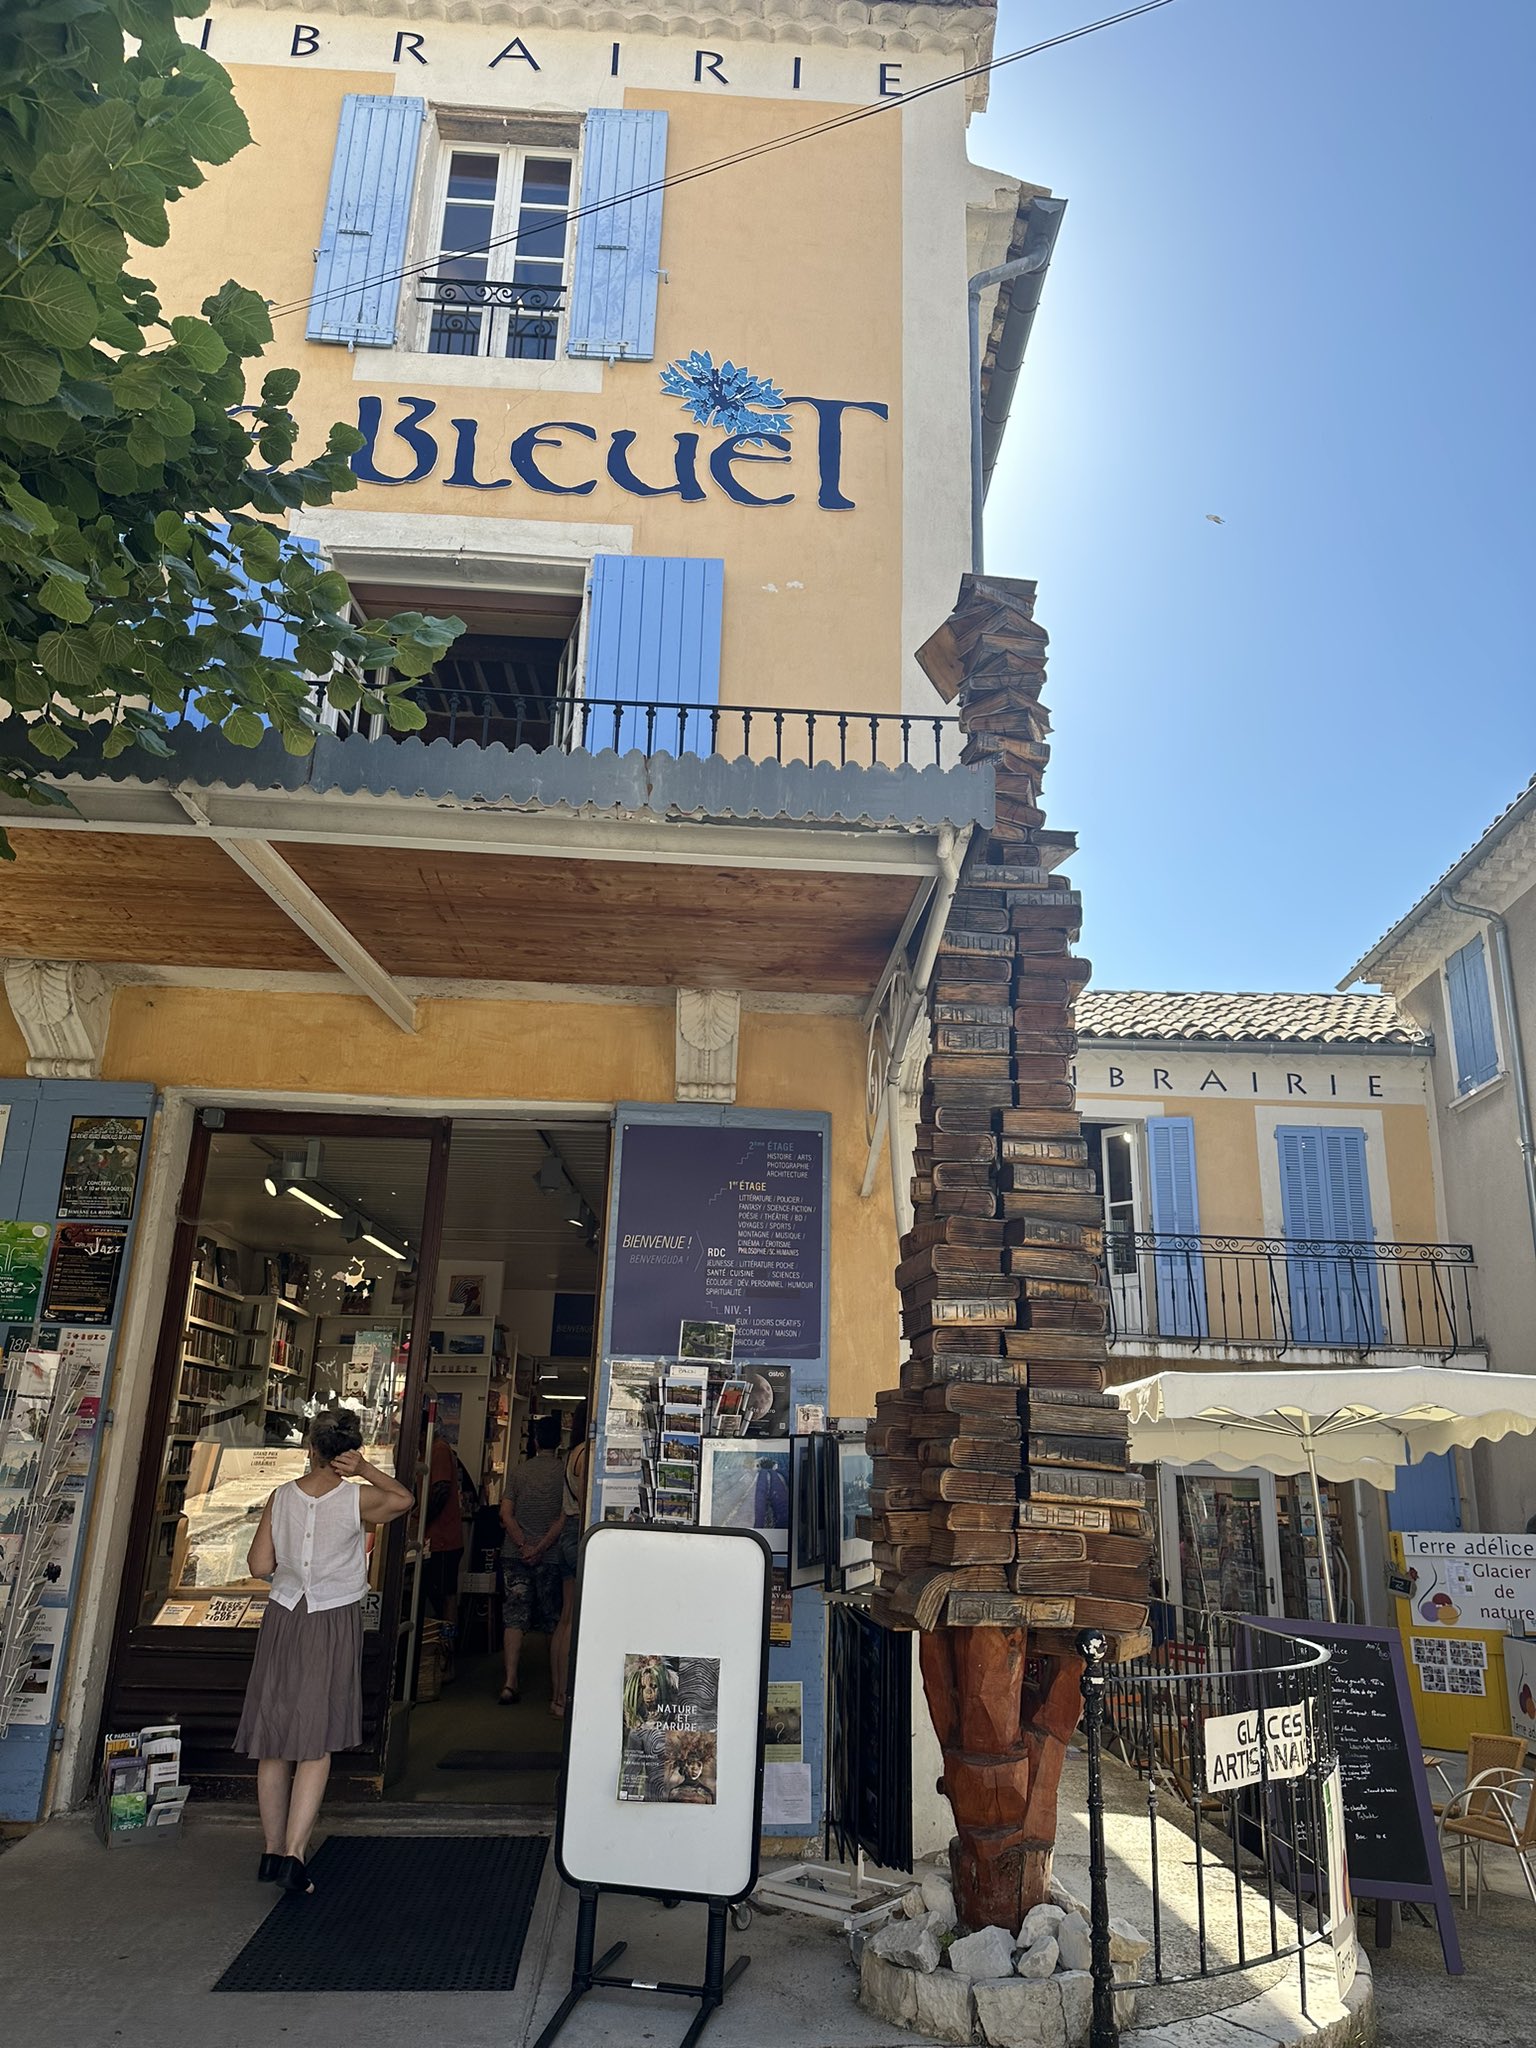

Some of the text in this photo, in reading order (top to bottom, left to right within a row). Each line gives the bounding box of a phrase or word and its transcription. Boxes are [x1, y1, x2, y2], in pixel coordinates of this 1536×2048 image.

[200, 18, 903, 98] IBRAIRIE
[1072, 1065, 1383, 1097] IBRAIRIE
[767, 1140, 794, 1151] ÉTAGE
[739, 1180, 767, 1191] ÉTAGE
[739, 1194, 772, 1202] LITTÉRATURE
[739, 1203, 814, 1213] FANTASY SCIENCE-FICTION
[738, 1211, 759, 1219] POÉSIE
[764, 1212, 789, 1221] THÉÂTRE
[738, 1221, 764, 1229] VOYAGES
[737, 1231, 801, 1240] MONTAGNE MUSIQUE
[622, 1234, 686, 1249] BIENVENUE
[737, 1239, 791, 1248] CINÉMA ÉROTISME
[707, 1248, 726, 1257] RDC
[629, 1254, 684, 1265] BENVENGUDA
[739, 1260, 775, 1268] LITTÉRATURE
[706, 1268, 726, 1277] SANTÉ
[772, 1271, 801, 1279] SCIENCES
[706, 1278, 733, 1286] ÉCOLOGIE
[750, 1279, 784, 1287] PERSONNEL
[705, 1287, 742, 1296] SPIRITUALITÉ
[735, 1318, 748, 1326] JEUX
[775, 1318, 801, 1327] CRÉATIFS
[1407, 1534, 1456, 1554] Terre
[1464, 1536, 1534, 1556] adélice
[1473, 1563, 1532, 1579] Glacier
[1494, 1584, 1515, 1599] de
[1480, 1607, 1535, 1621] nature
[657, 1704, 698, 1714] NATURE
[677, 1714, 689, 1722] ET
[656, 1721, 697, 1732] PARURE
